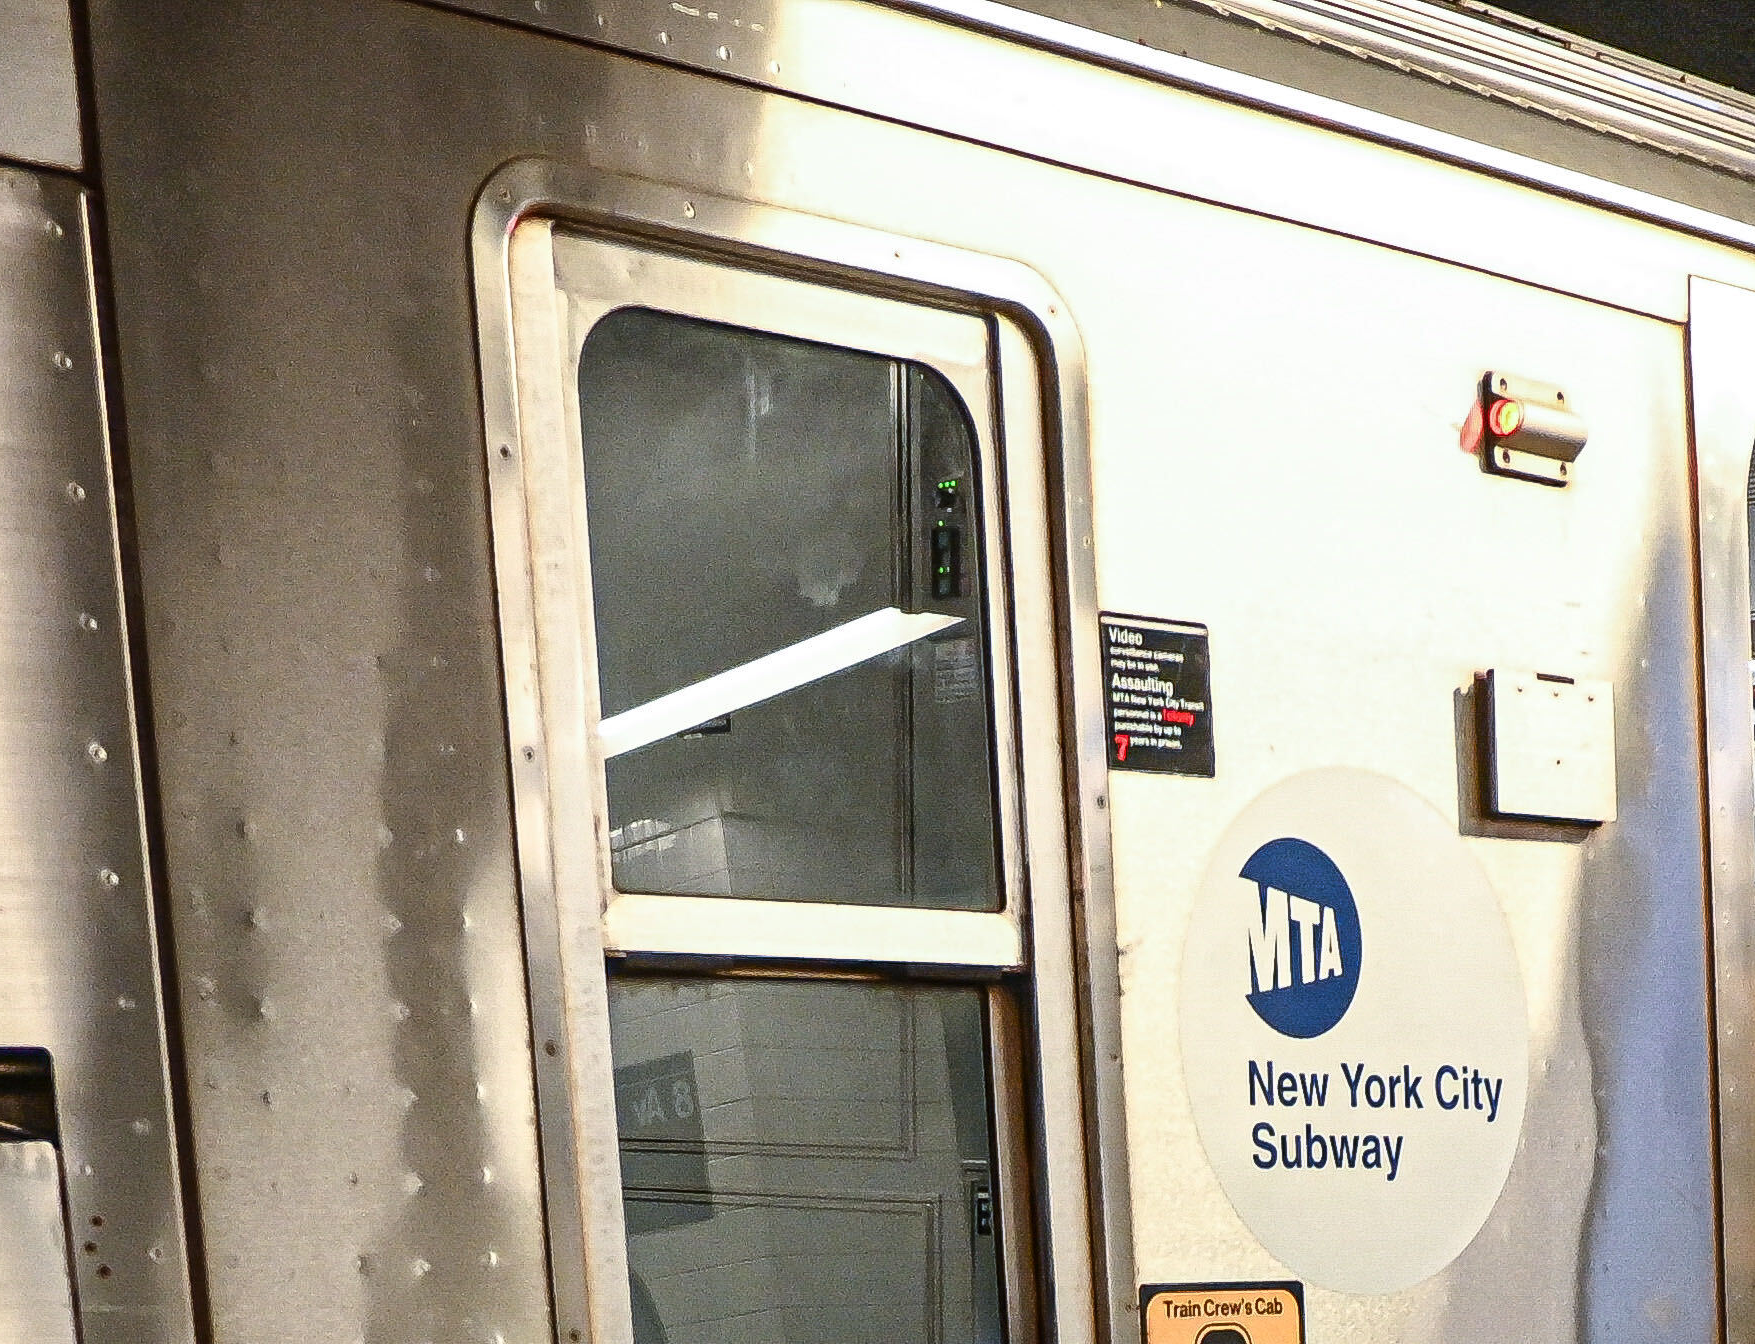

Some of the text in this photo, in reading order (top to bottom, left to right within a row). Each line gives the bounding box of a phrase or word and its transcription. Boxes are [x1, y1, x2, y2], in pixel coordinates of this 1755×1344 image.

[1109, 626, 1143, 646] Video
[1112, 672, 1174, 698] Assaulting
[1114, 734, 1129, 761] 7
[1241, 873, 1344, 997] MTA
[1248, 1059, 1503, 1124] New York City
[1250, 1121, 1404, 1182] Subway
[1163, 1296, 1284, 1319] Train Crew's Cab
